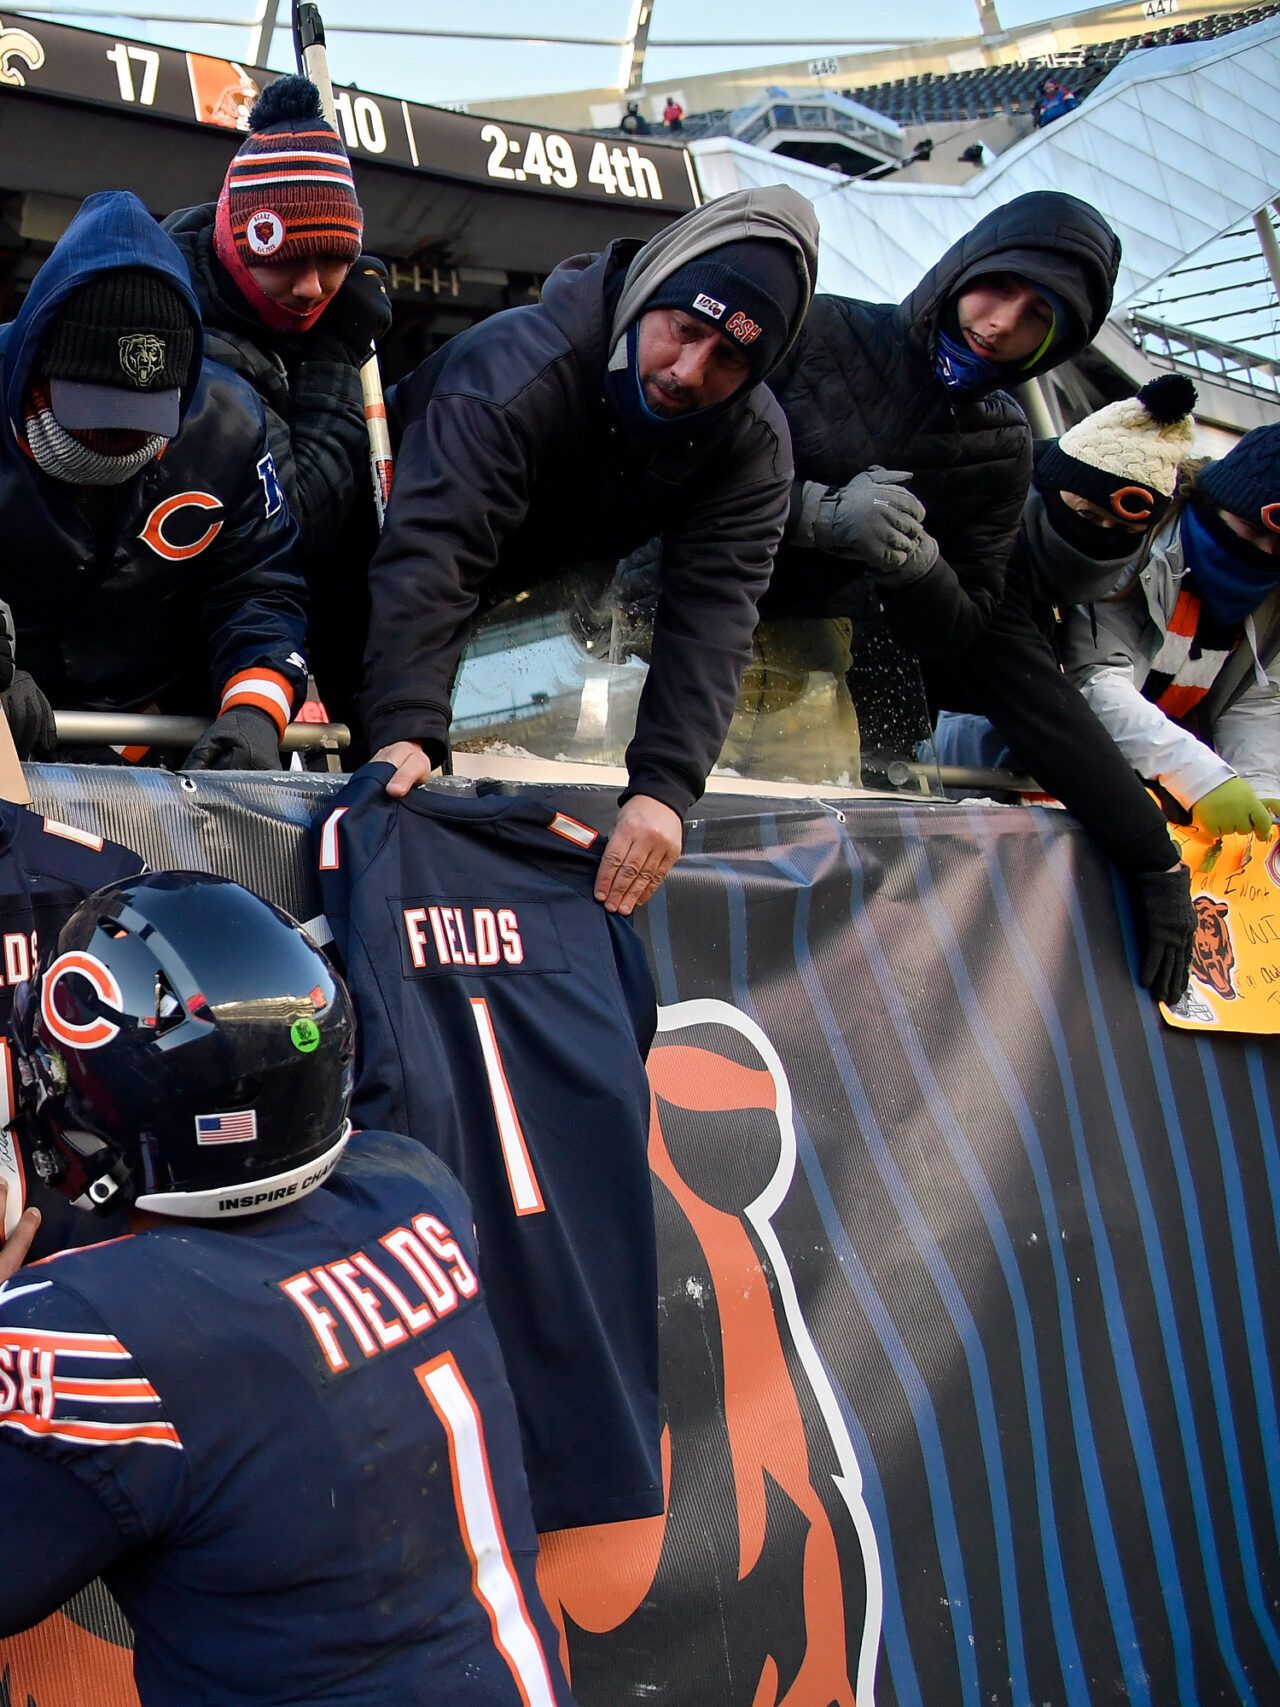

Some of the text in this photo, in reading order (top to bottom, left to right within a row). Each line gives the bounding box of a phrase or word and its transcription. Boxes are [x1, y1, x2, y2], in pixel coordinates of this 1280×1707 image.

[106, 43, 160, 105] 17
[332, 92, 387, 154] 10
[481, 125, 663, 200] 2:49 4th
[725, 311, 762, 345] GSH
[403, 906, 524, 968] FIELDS
[468, 997, 546, 1216] 1
[218, 1182, 298, 1211] INSPIRE
[279, 1212, 478, 1373] FIELDS
[413, 1349, 558, 1707] 1
